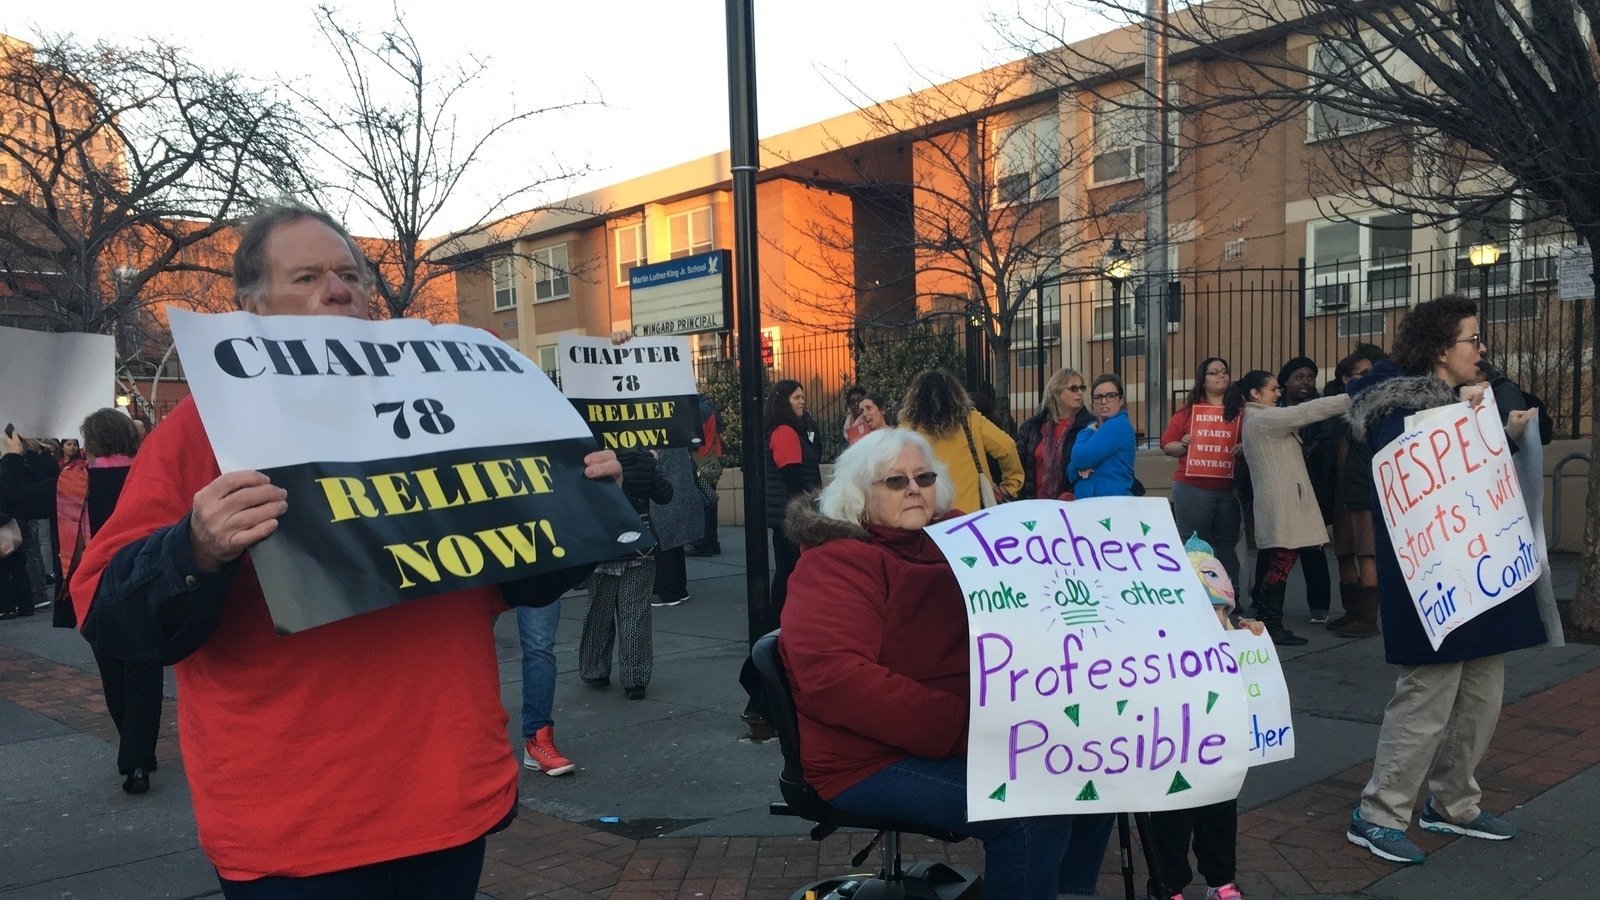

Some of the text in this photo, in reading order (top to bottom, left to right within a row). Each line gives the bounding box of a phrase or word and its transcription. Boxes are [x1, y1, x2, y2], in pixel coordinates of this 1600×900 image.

[632, 276, 649, 285] Martin
[649, 272, 666, 282] Luther
[667, 269, 680, 279] King
[687, 263, 707, 273] School
[643, 320, 675, 336] WINGARD
[677, 314, 717, 330] PRINCIPAL
[213, 336, 524, 379] CHAPTER
[569, 345, 681, 365] CHAPTER
[612, 374, 641, 392] 78
[373, 397, 456, 440] 78
[586, 401, 676, 422] RELIEF
[602, 428, 670, 449] NOW!
[1197, 429, 1232, 438] STARTS
[1197, 444, 1221, 453] WITH
[1190, 459, 1233, 468] CONTRACT
[1379, 405, 1506, 528] R.E.S.P.E.C
[314, 455, 554, 524] RELIEF
[1486, 462, 1520, 511] wit
[383, 519, 566, 590] NOW!
[945, 508, 1181, 572] Teachers
[1467, 533, 1489, 558] a
[968, 578, 1186, 614] make all other
[1418, 582, 1457, 637] Fair
[976, 630, 1239, 707] Professions
[1247, 683, 1261, 698] a
[1008, 703, 1227, 781] Possible
[1249, 714, 1291, 757] her
